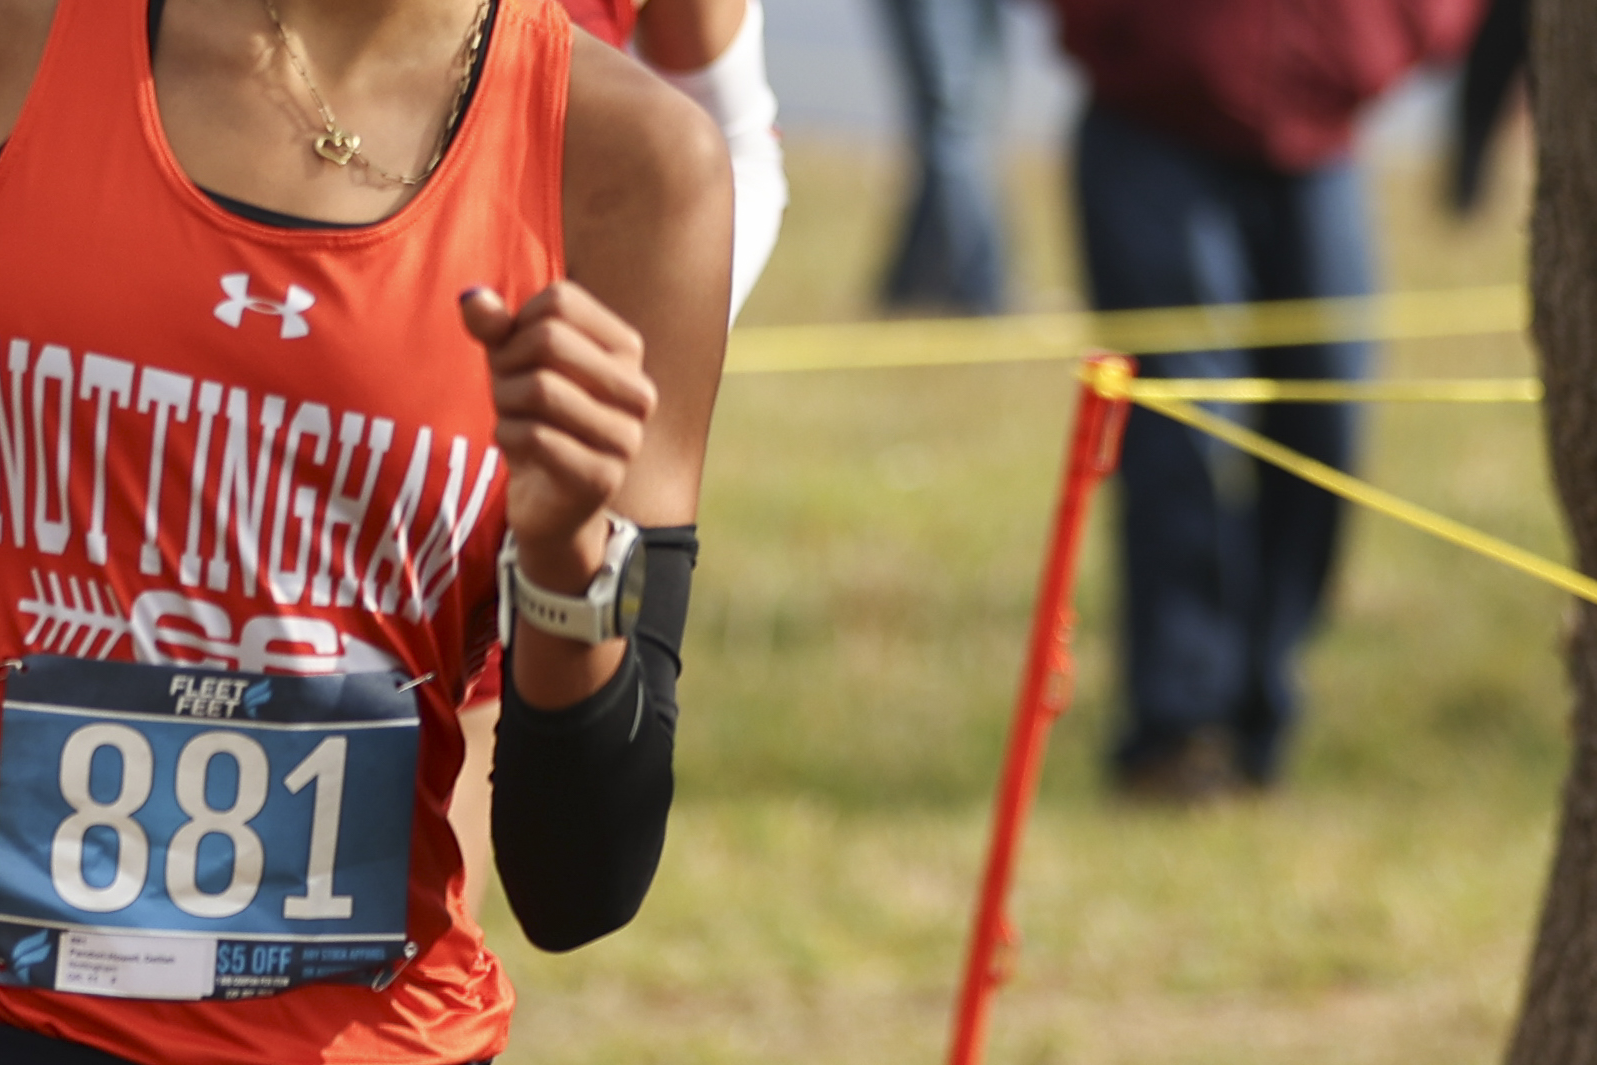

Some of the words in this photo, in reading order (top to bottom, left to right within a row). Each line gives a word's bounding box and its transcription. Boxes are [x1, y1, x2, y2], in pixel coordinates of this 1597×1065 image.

[169, 674, 250, 702] FLEET
[175, 693, 241, 719] FEET
[49, 722, 354, 921] 881
[217, 944, 246, 975] $5
[251, 946, 293, 975] OFF
